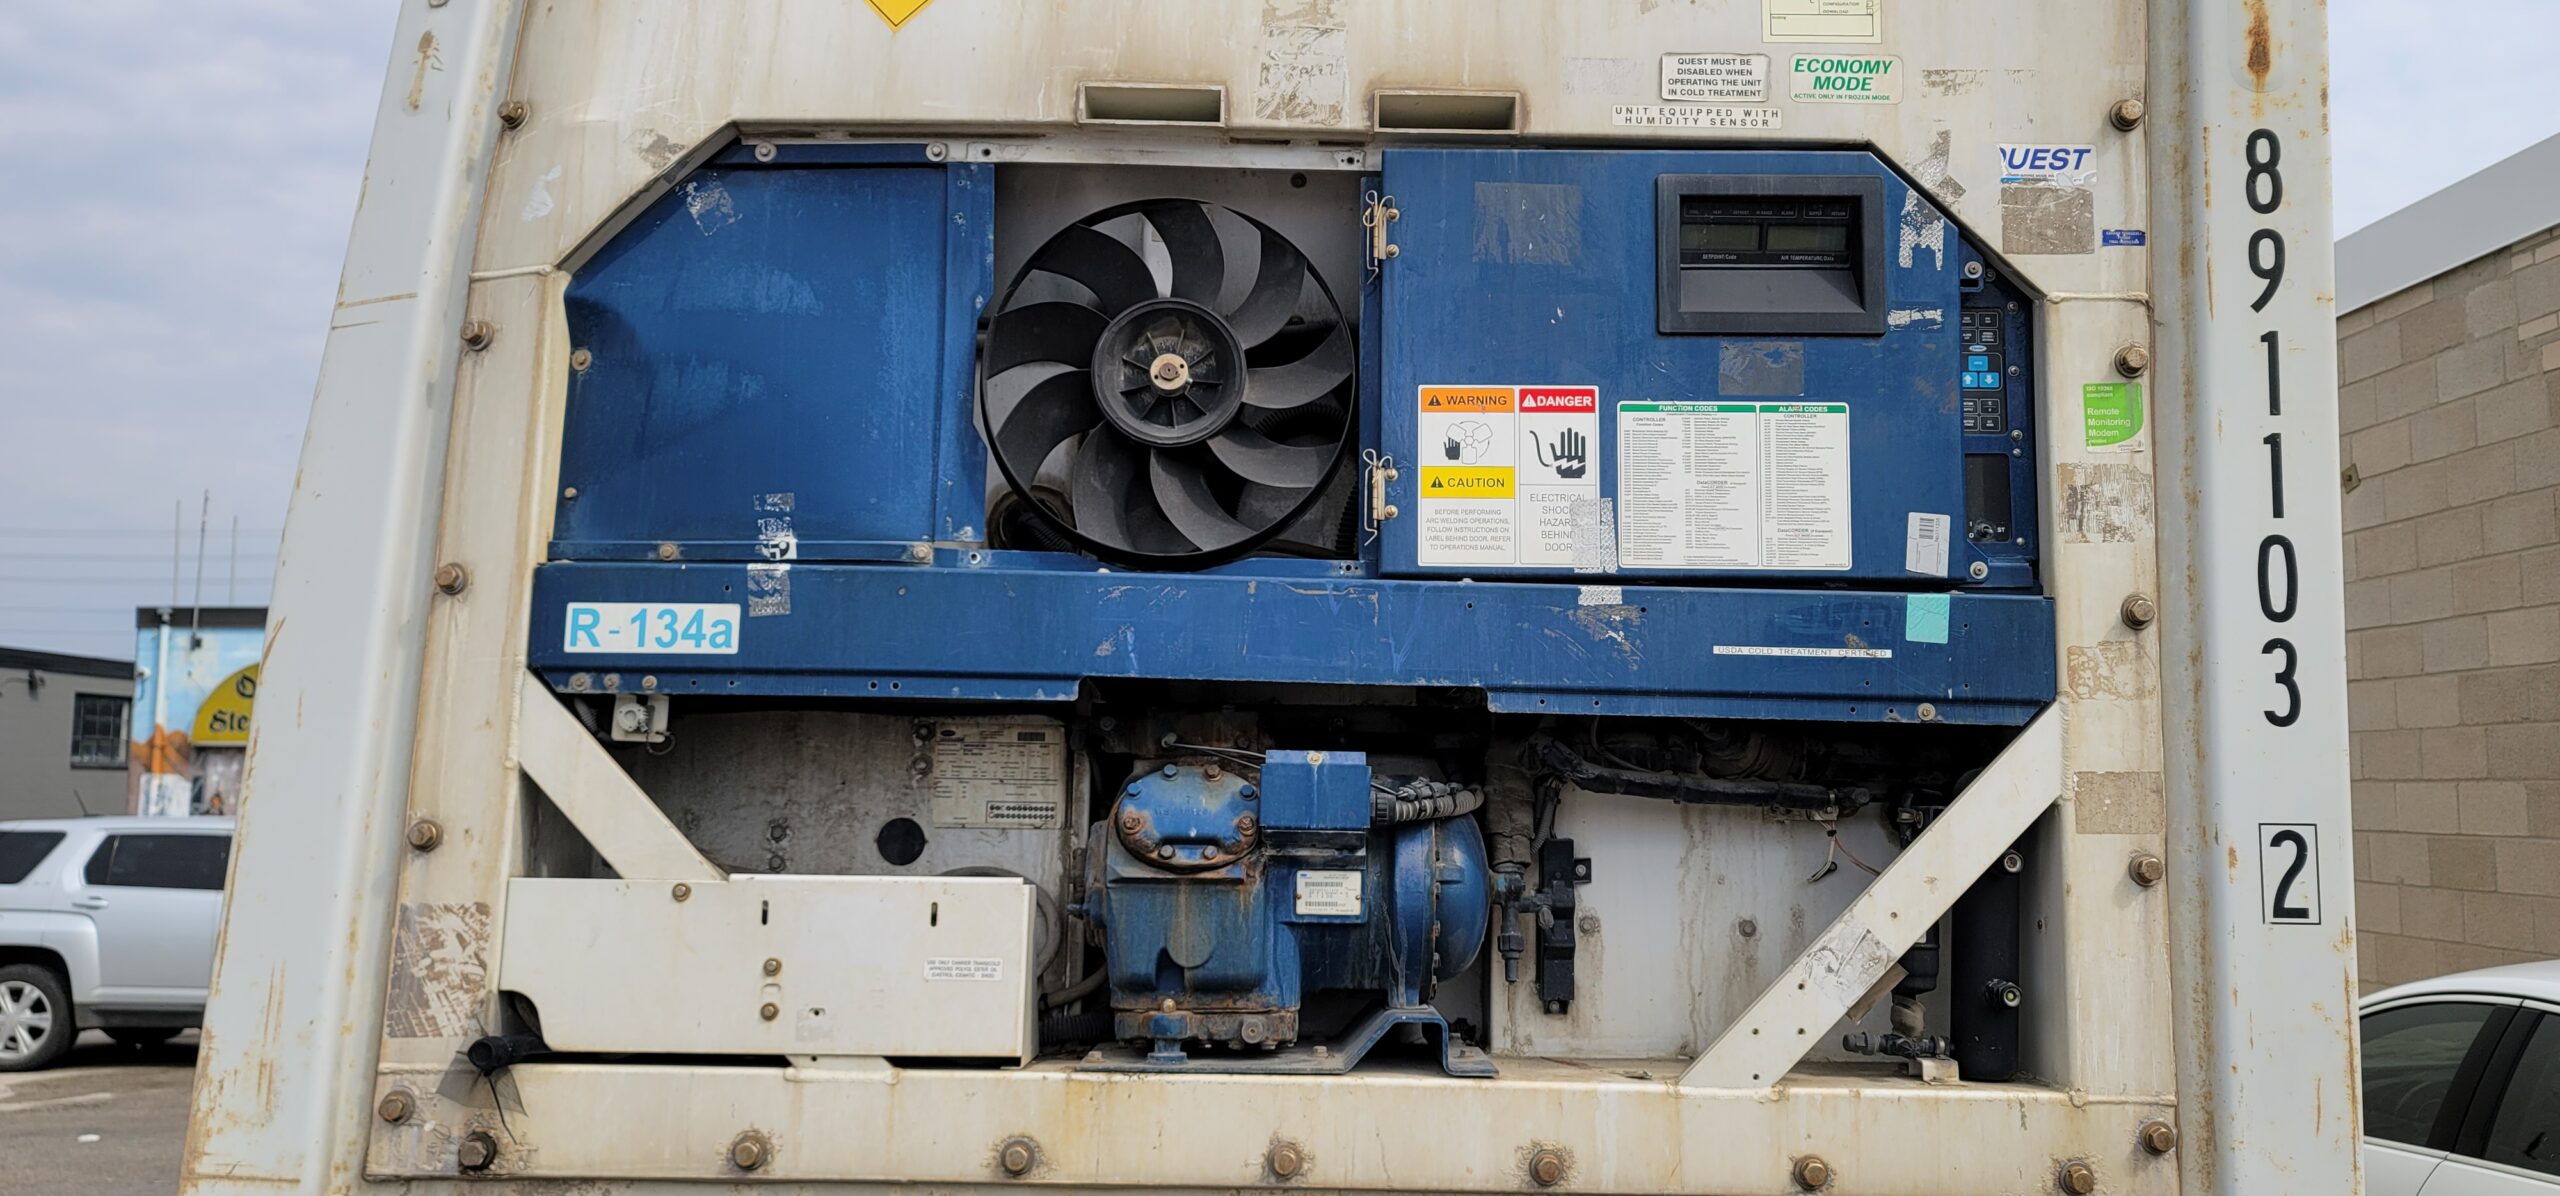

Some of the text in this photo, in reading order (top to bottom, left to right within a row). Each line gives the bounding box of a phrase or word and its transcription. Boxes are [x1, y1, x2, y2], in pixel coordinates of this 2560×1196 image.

[1677, 57, 1752, 66] QUEST MUST BE
[1793, 58, 1893, 75] ECONOMY
[1677, 67, 1753, 76] DISABLED WHEN
[1668, 78, 1762, 87] OPERATING THE UNIT
[1812, 76, 1874, 91] MODE
[1668, 88, 1762, 98] IN COLD TREATMENT
[1615, 107, 1779, 118] UNIT EQUIPPED WITH
[1625, 116, 1770, 127] HUMIDITY SENSOR
[1999, 147, 2092, 171] UEST
[1446, 395, 1507, 406] WARNING
[1537, 396, 1592, 407] DANGER
[2087, 407, 2120, 416] Remote
[2087, 418, 2131, 427] Monitoring
[2088, 429, 2120, 437] Modem
[1447, 478, 1505, 488] CAUTION
[1529, 493, 1586, 503] ELECTRICAL
[1544, 543, 1573, 552] DOOR
[1748, 647, 1773, 655] COLD
[1779, 648, 1833, 656] TREATMENT
[2269, 829, 2310, 919] 2
